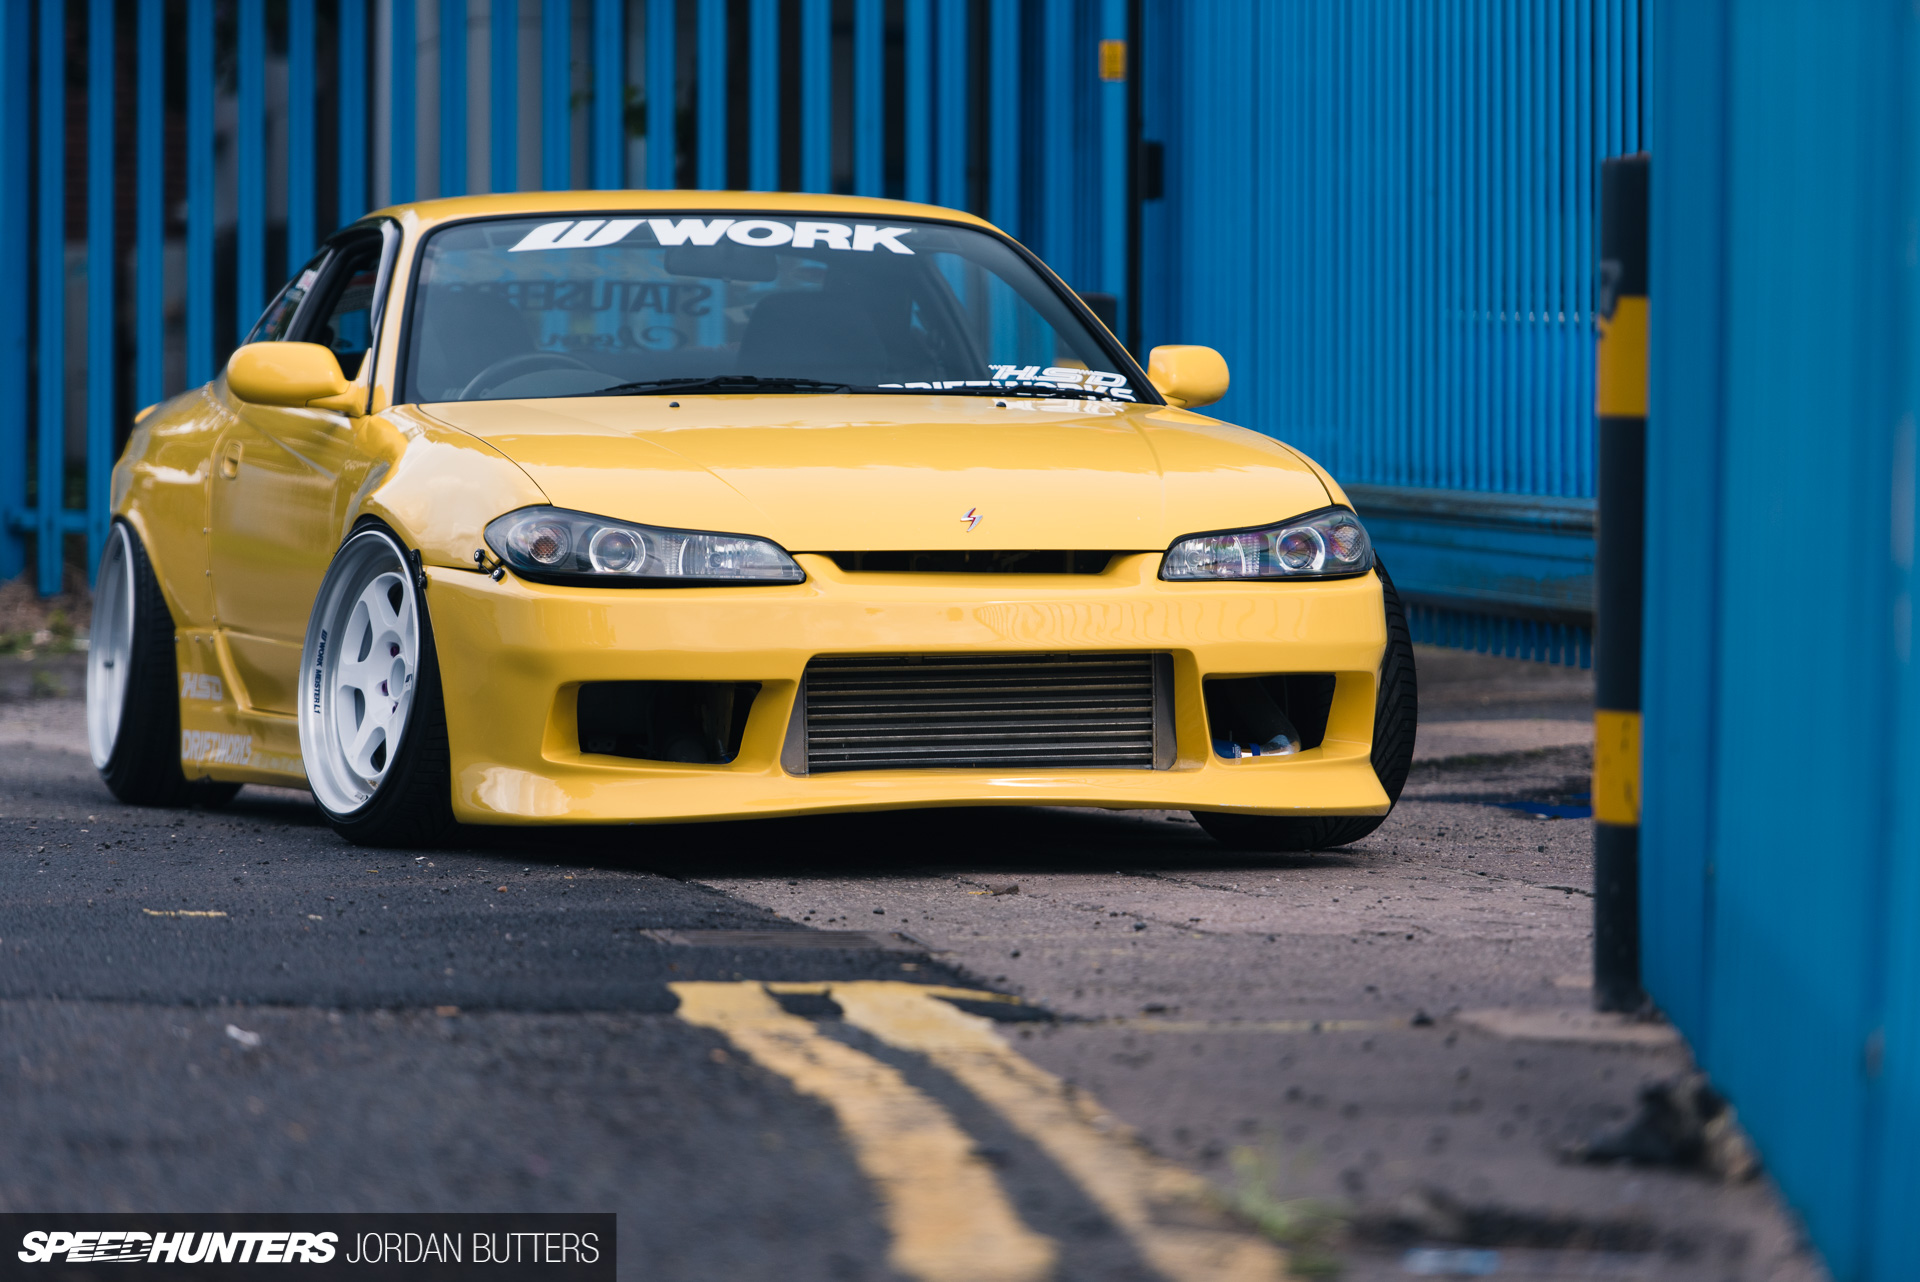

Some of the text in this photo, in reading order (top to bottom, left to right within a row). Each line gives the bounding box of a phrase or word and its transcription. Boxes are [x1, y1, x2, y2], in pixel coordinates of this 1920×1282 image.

[648, 219, 915, 254] WORK
[988, 364, 1127, 388] HSD
[316, 641, 326, 668] WORK
[313, 669, 322, 703] MEISTER
[181, 729, 252, 766] DRIFTWORKS
